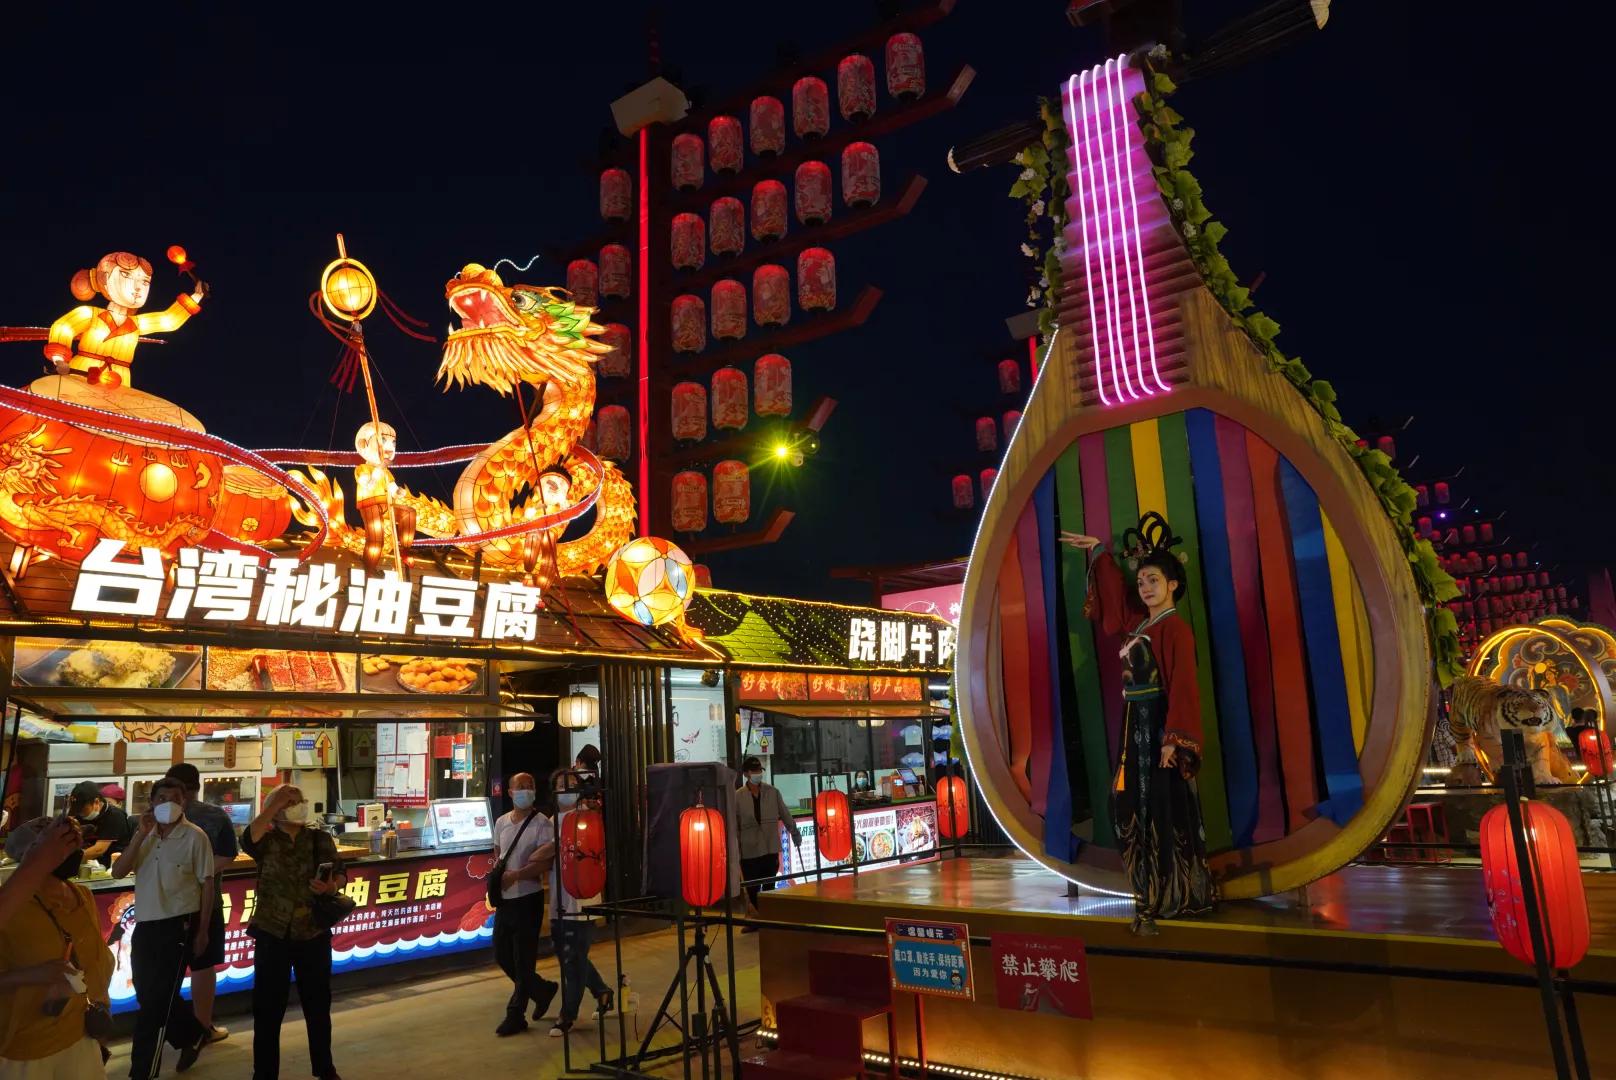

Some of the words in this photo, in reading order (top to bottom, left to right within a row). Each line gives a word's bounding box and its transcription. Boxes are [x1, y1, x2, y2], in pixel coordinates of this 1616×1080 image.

[71, 540, 540, 641] 台湾秘油豆腐
[742, 672, 782, 693] 好食材
[812, 674, 848, 694] 好味道
[872, 676, 903, 696] 好产品
[1002, 954, 1080, 983] 禁止攀爬
